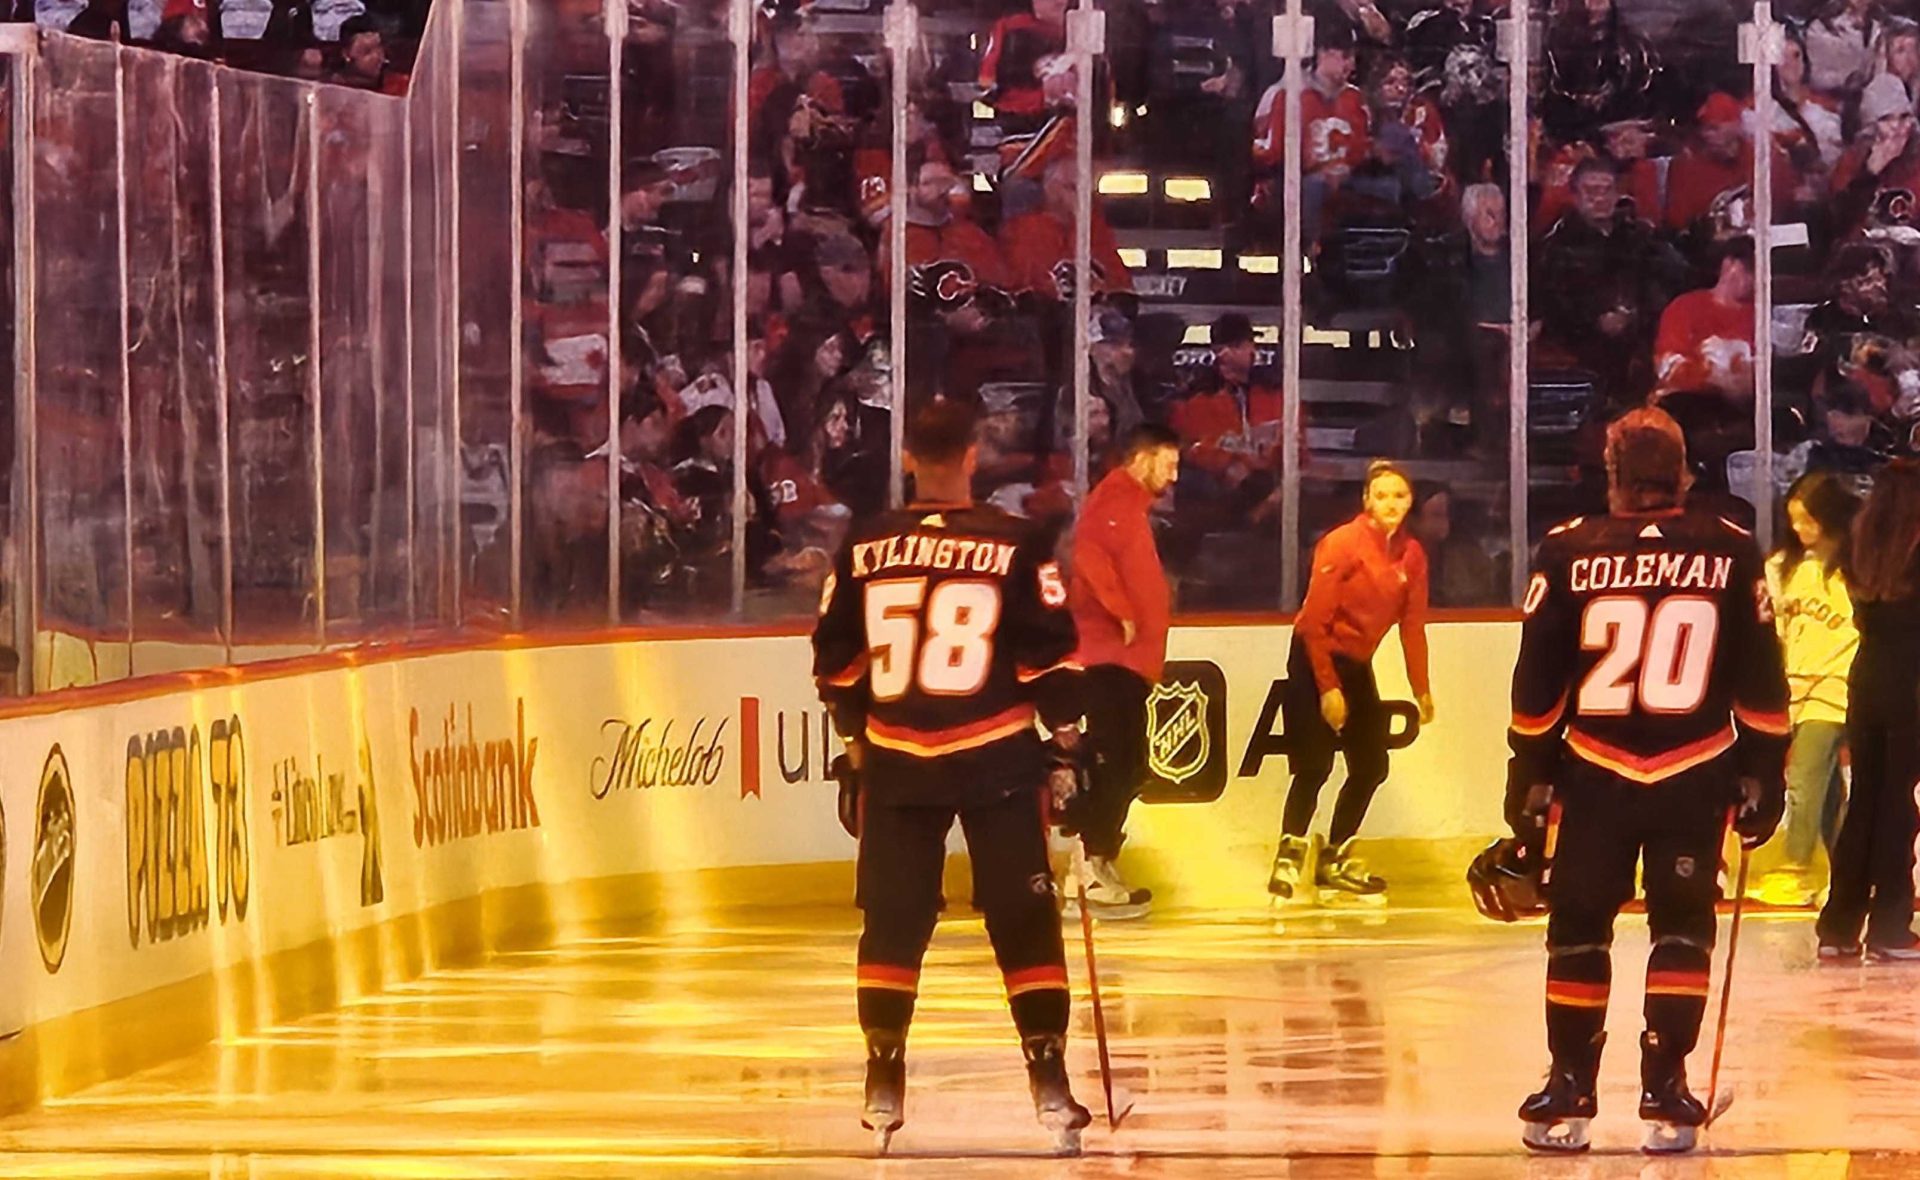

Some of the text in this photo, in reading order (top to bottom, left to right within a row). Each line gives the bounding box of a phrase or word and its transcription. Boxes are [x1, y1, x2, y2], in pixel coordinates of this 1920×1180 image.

[852, 534, 1016, 577] KYLINGTON
[1570, 552, 1733, 592] COLEMAN
[864, 575, 1002, 702] 58
[1576, 594, 1719, 715] 20
[409, 696, 542, 850] Scotiabank
[590, 716, 730, 801] Michelob
[1154, 709, 1197, 760] NHL
[125, 722, 210, 951] PIZZA
